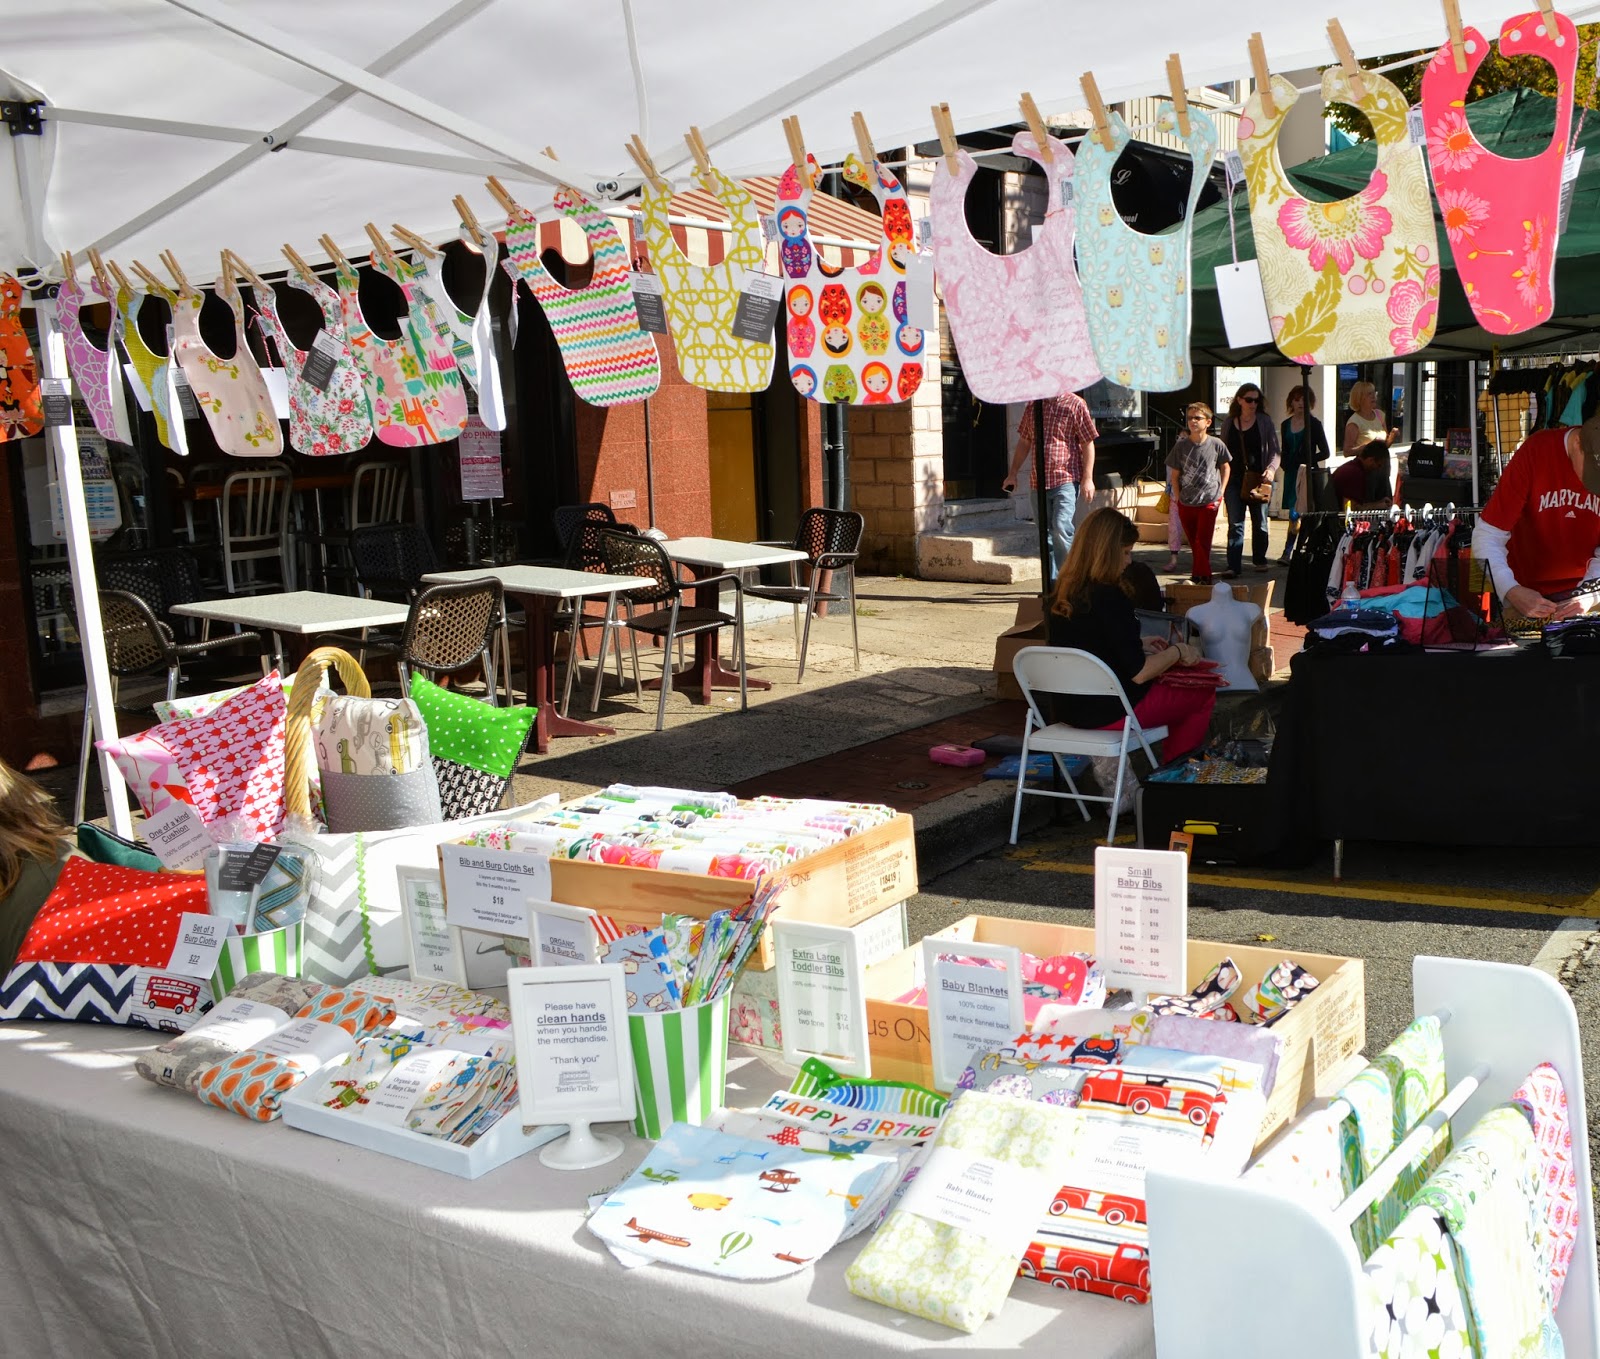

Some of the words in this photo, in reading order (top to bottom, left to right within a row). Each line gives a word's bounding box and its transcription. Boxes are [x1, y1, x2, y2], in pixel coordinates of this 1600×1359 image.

[1538, 489, 1600, 517] MARYLAN
[148, 827, 162, 839] One
[163, 822, 170, 831] of
[175, 812, 190, 825] kind
[162, 824, 189, 843] Cushion
[460, 857, 471, 865] Bib
[486, 861, 502, 871] Burp
[503, 863, 522, 872] Cloth
[523, 865, 534, 874] Set
[1128, 867, 1152, 876] Small
[1117, 878, 1139, 888] Baby
[1143, 879, 1162, 889] Bibs
[492, 896, 504, 905] $18
[193, 924, 202, 932] Set
[185, 934, 197, 943] Burp
[199, 936, 217, 946] Cloths
[550, 937, 575, 946] ORGANIC
[542, 944, 550, 952] Bib
[557, 947, 570, 956] Burp
[571, 950, 585, 959] Cloth
[793, 949, 814, 959] Extra
[817, 952, 840, 963] Large
[190, 954, 200, 963] $22
[433, 964, 443, 972] $44
[791, 961, 823, 972] Toddler
[825, 965, 844, 975] Bibs
[942, 979, 965, 991] Baby
[968, 982, 1008, 996] Blankets
[545, 1003, 573, 1011] Please
[576, 1002, 596, 1010] have
[537, 1015, 567, 1023] clean
[571, 1012, 606, 1022] hands
[798, 1008, 812, 1016] plain
[836, 1013, 848, 1021] $12
[960, 1016, 973, 1024] thick
[975, 1019, 995, 1028] flannel
[562, 1027, 577, 1035] you
[553, 1035, 608, 1044] merchandise.
[953, 1033, 982, 1042] measures
[983, 1038, 1003, 1046] approx
[392, 1084, 403, 1092] Burp
[403, 1086, 417, 1094] Cloth
[766, 1096, 848, 1127] HAPPY
[946, 1183, 963, 1193] Baby
[965, 1188, 994, 1203] Blanket
